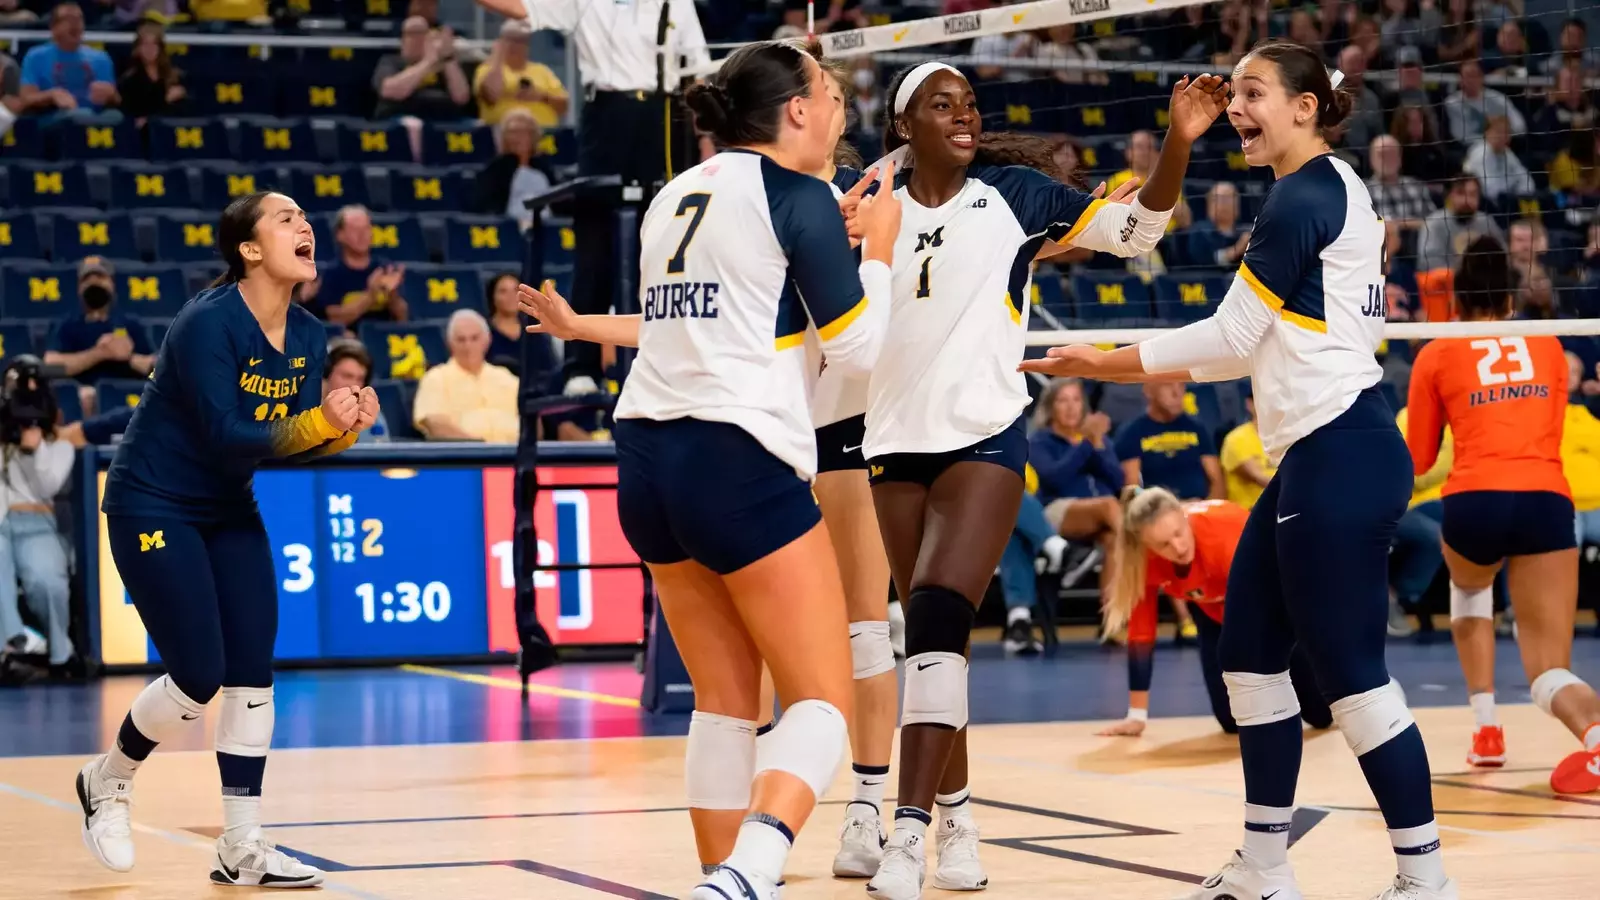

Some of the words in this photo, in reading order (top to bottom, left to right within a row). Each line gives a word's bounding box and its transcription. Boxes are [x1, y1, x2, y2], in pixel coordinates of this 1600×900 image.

[943, 13, 982, 35] MICHIGAN
[87, 127, 114, 146] M
[177, 127, 202, 147] M
[264, 129, 290, 148] M
[361, 131, 387, 150] M
[447, 133, 473, 152] M
[35, 172, 62, 193] M
[136, 175, 164, 195] M
[228, 175, 256, 196] M
[315, 175, 342, 196] M
[414, 178, 441, 198] M
[79, 222, 109, 245] M
[184, 224, 214, 246] M
[371, 225, 398, 247] M
[471, 226, 500, 248] M
[666, 191, 713, 276] 7
[914, 225, 945, 253] M
[129, 276, 160, 300] M
[915, 255, 934, 299] 1
[29, 277, 60, 301] M
[427, 279, 458, 302] M
[644, 281, 719, 322] BURKE
[1470, 336, 1534, 386] 23
[239, 371, 305, 398] MICHGA
[1470, 384, 1549, 408] ILLINOIS
[328, 494, 353, 515] M
[330, 517, 355, 538] 13
[361, 518, 384, 557] 2
[138, 530, 166, 552] M
[331, 541, 356, 563] 12
[283, 543, 315, 593] 3
[355, 581, 451, 623] 1:30
